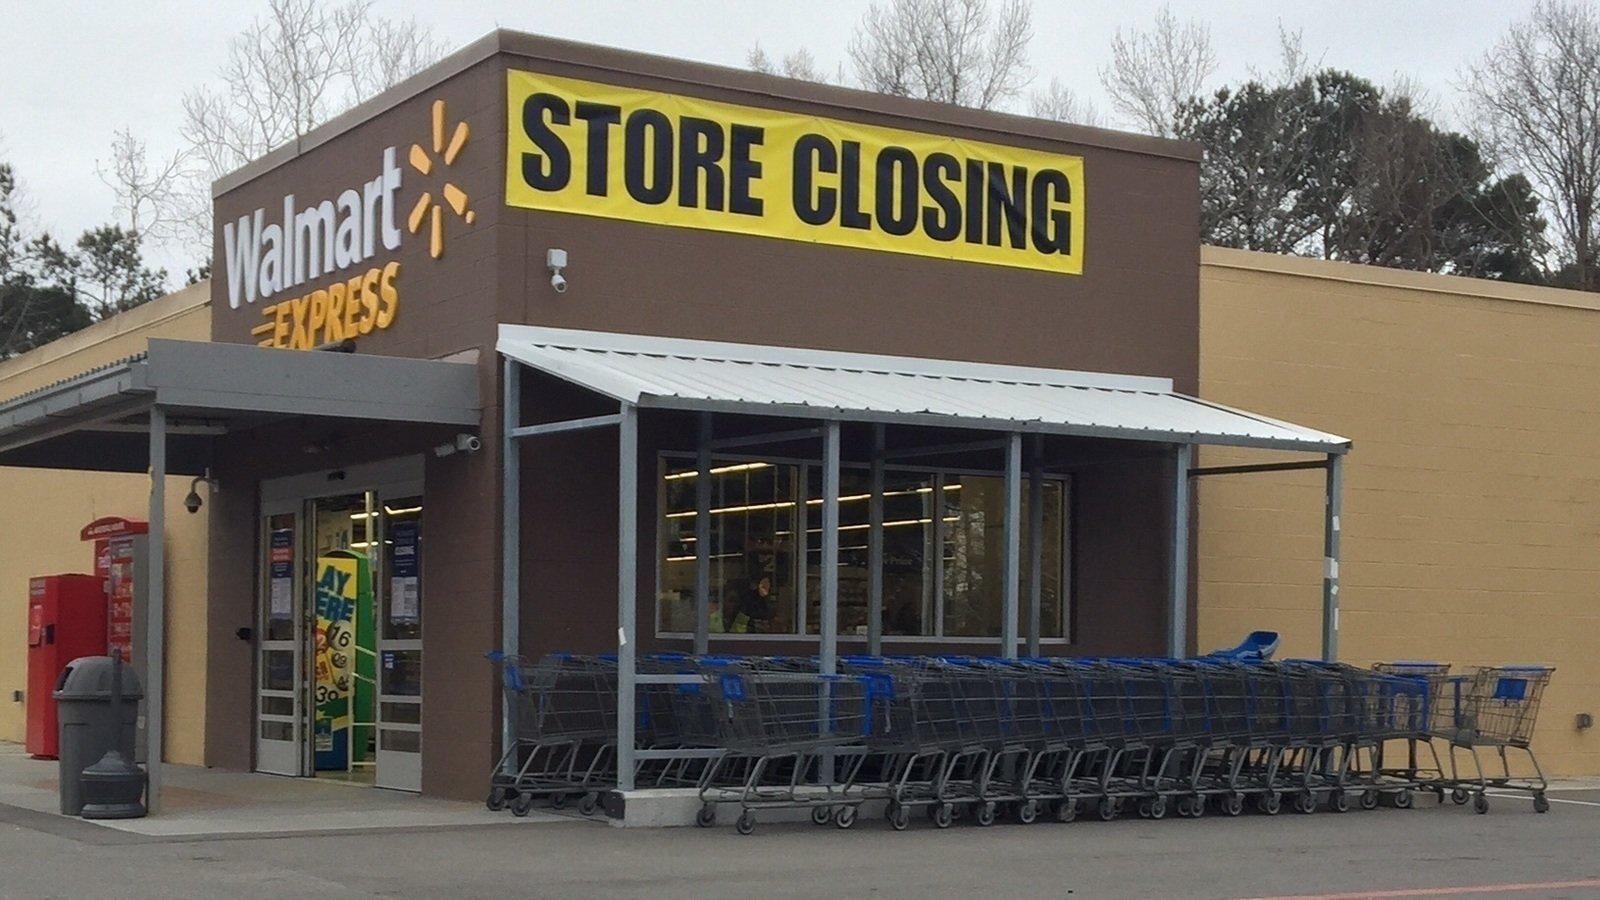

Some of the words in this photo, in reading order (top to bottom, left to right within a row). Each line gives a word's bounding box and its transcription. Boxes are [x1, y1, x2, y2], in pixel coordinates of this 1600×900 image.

[224, 146, 402, 309] Walmart
[521, 92, 765, 217] STORE
[792, 133, 1072, 256] CLOSING
[273, 261, 401, 350] EXPRESS
[331, 626, 351, 647] 16
